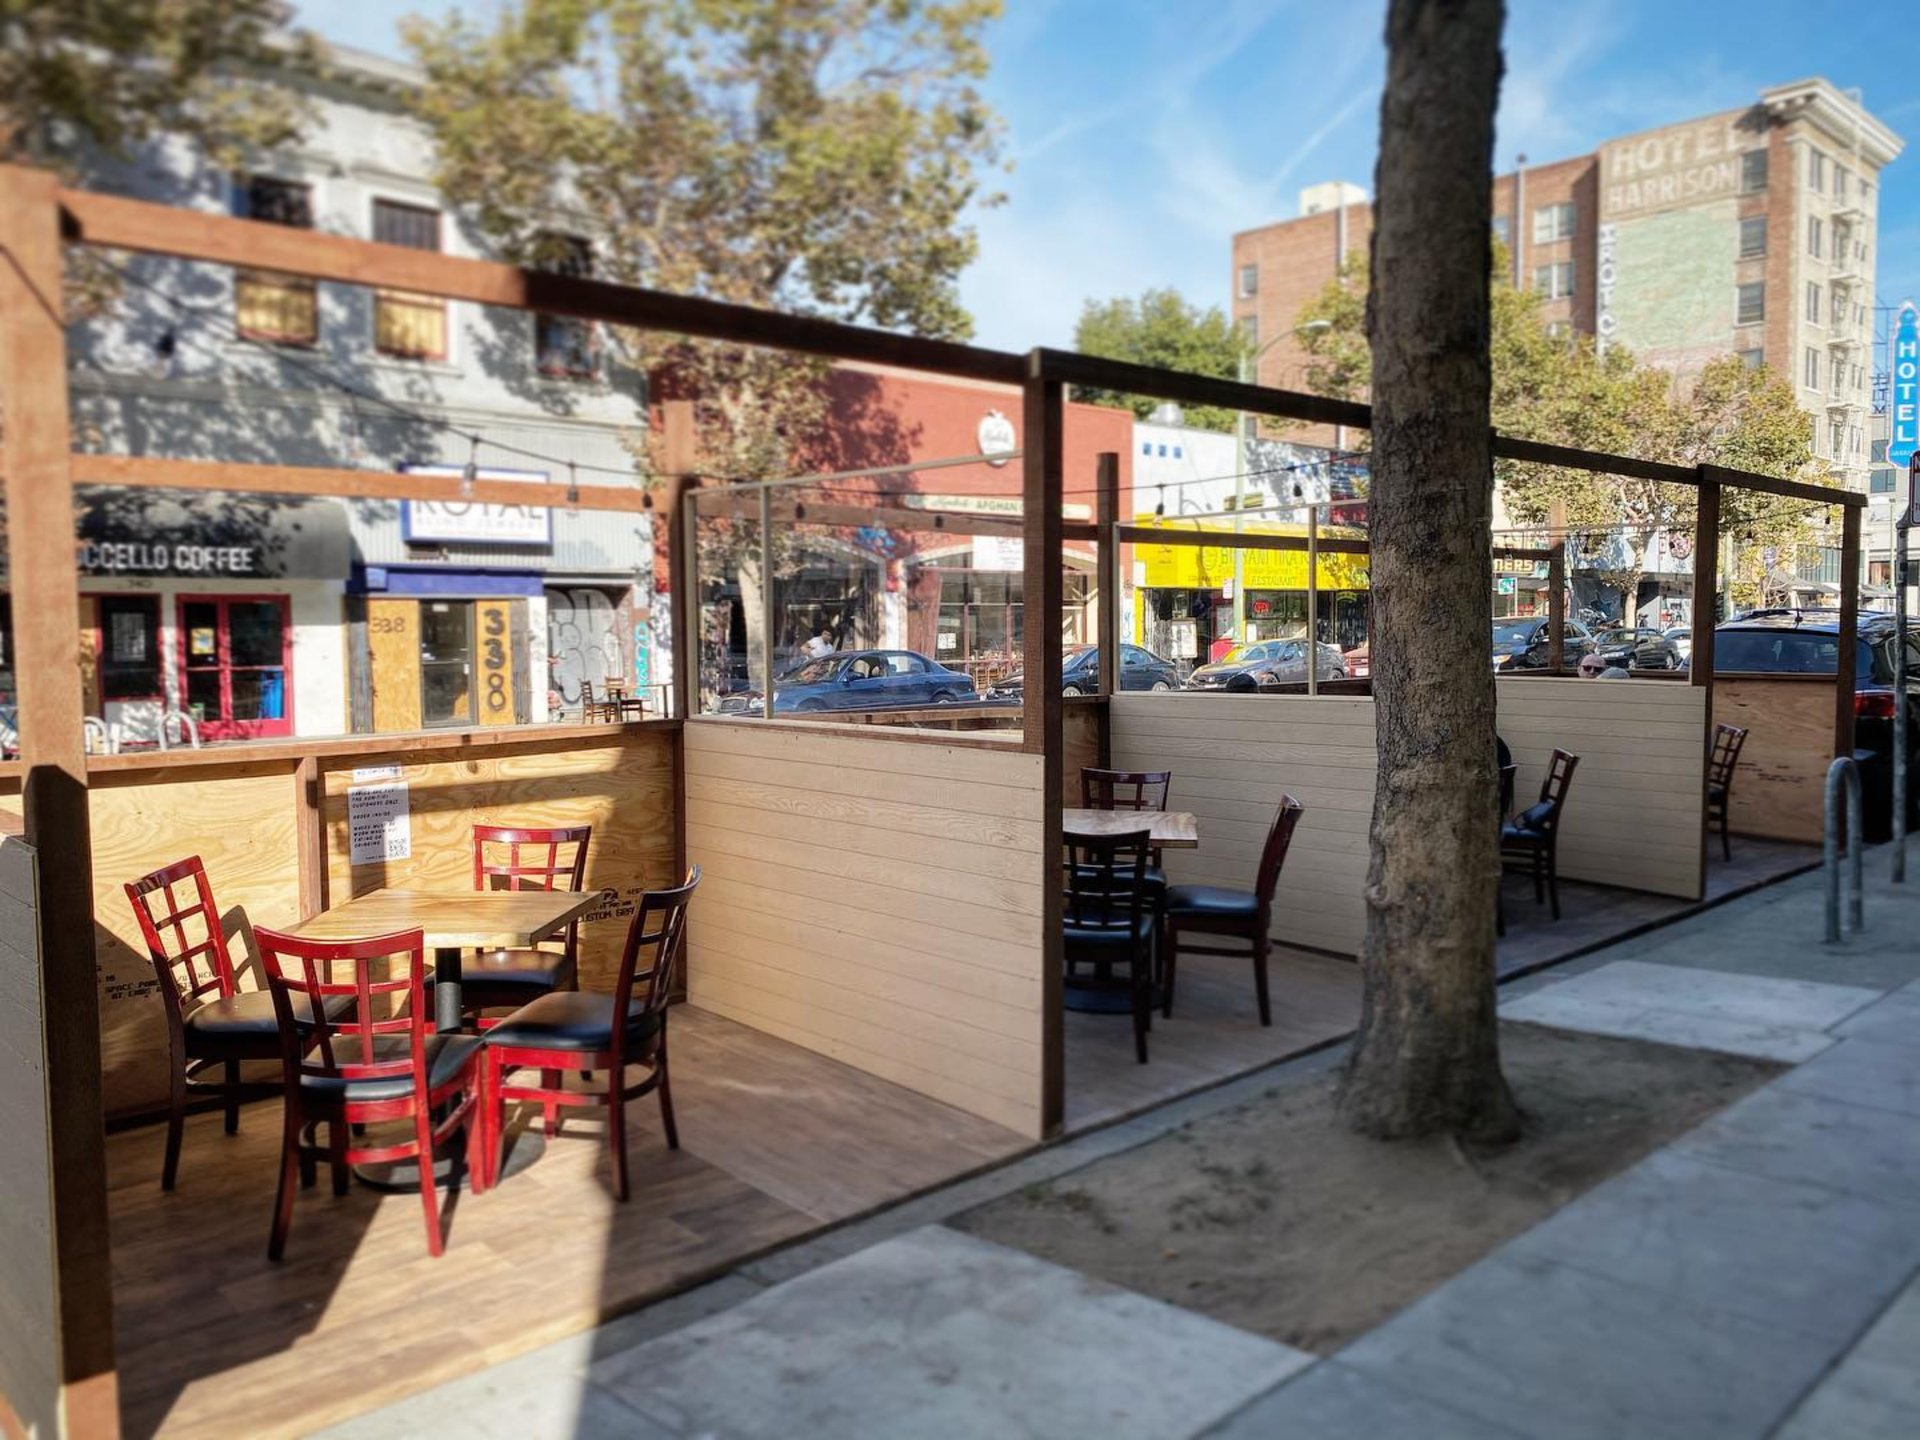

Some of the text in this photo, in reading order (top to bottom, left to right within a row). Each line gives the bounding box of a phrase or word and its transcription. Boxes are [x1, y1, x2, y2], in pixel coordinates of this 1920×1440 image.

[1611, 119, 1754, 178] HOTEL
[1608, 160, 1737, 212] HARRISON
[1897, 341, 1917, 442] HOTEL
[79, 542, 253, 571] CCELLO COFFEE
[1220, 548, 1269, 566] BIYANI
[370, 616, 406, 633] 338
